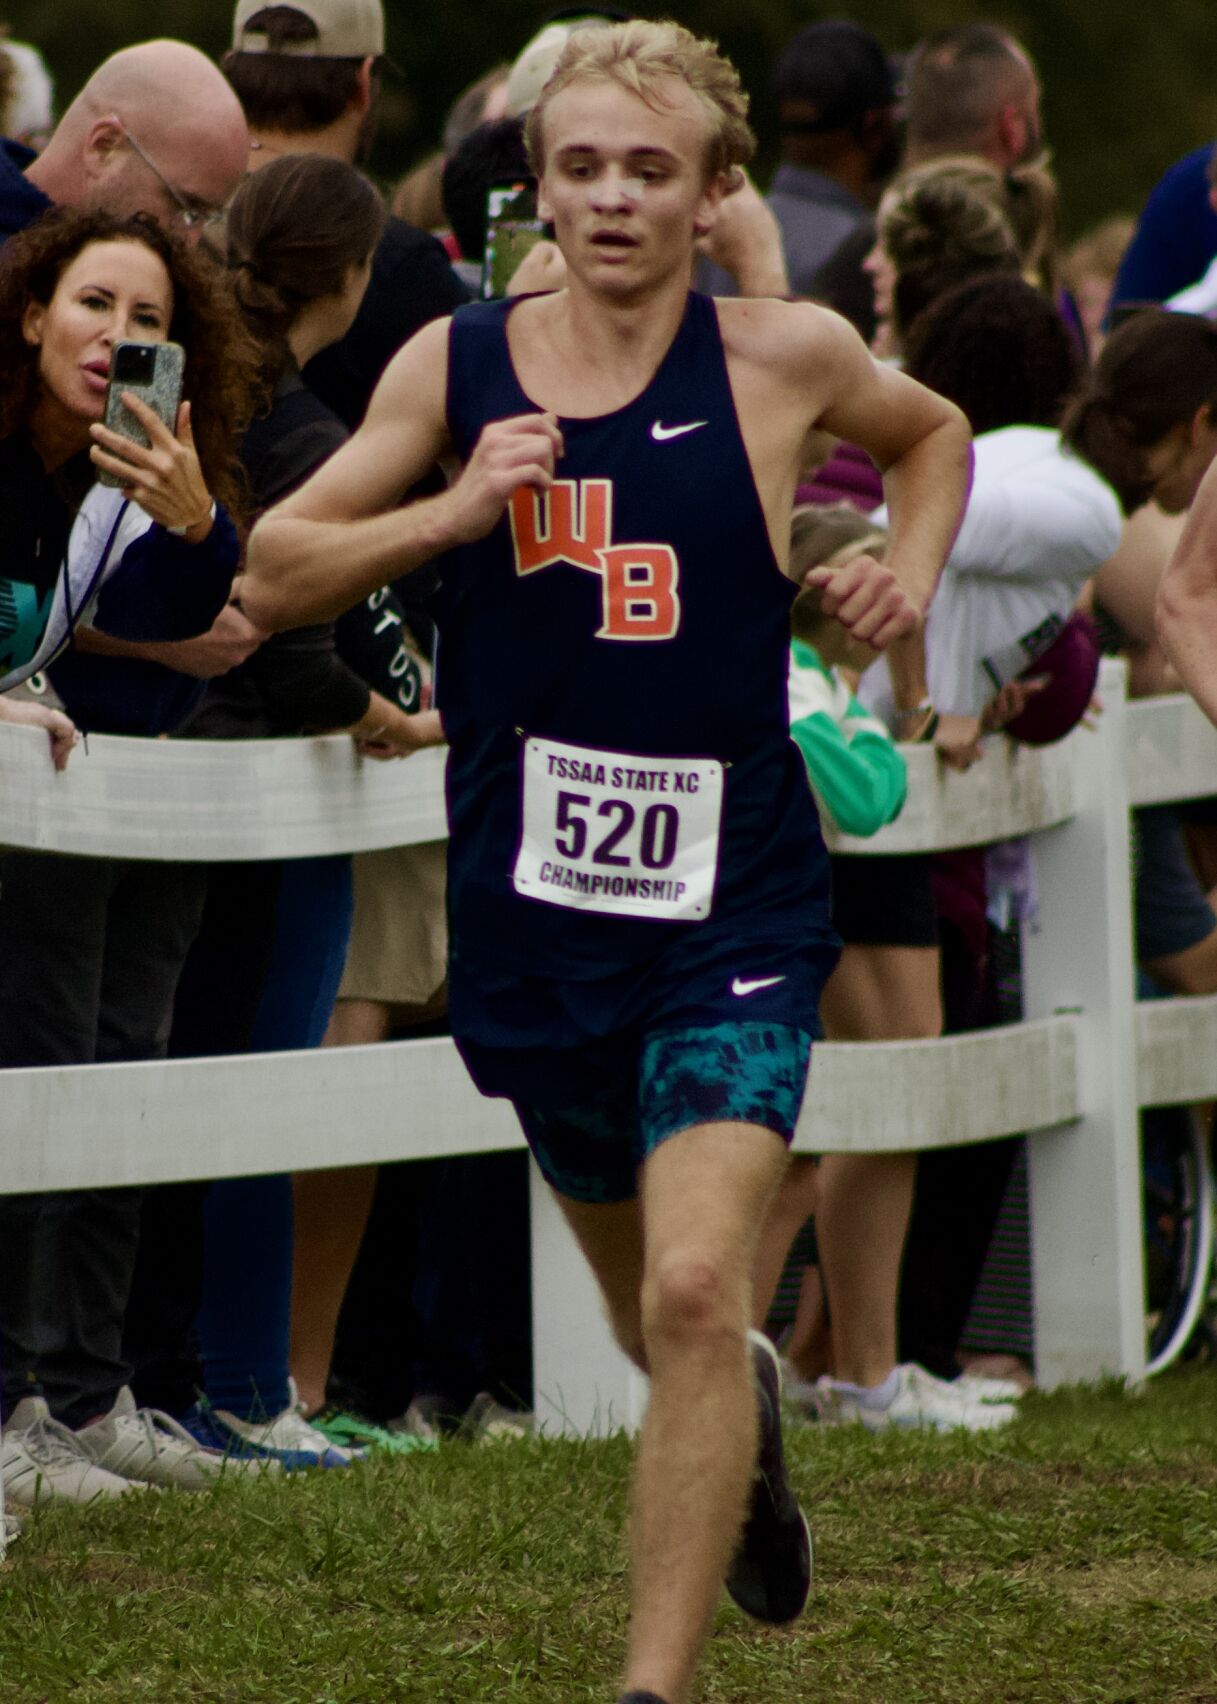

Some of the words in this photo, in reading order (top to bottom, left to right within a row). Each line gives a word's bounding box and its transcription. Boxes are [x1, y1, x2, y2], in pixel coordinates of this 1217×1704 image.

[547, 754, 606, 786] TSSAA
[611, 767, 669, 793] STATE
[673, 771, 700, 794] XC
[555, 790, 680, 871] 520
[539, 861, 687, 902] CHAMPIONSHIP
